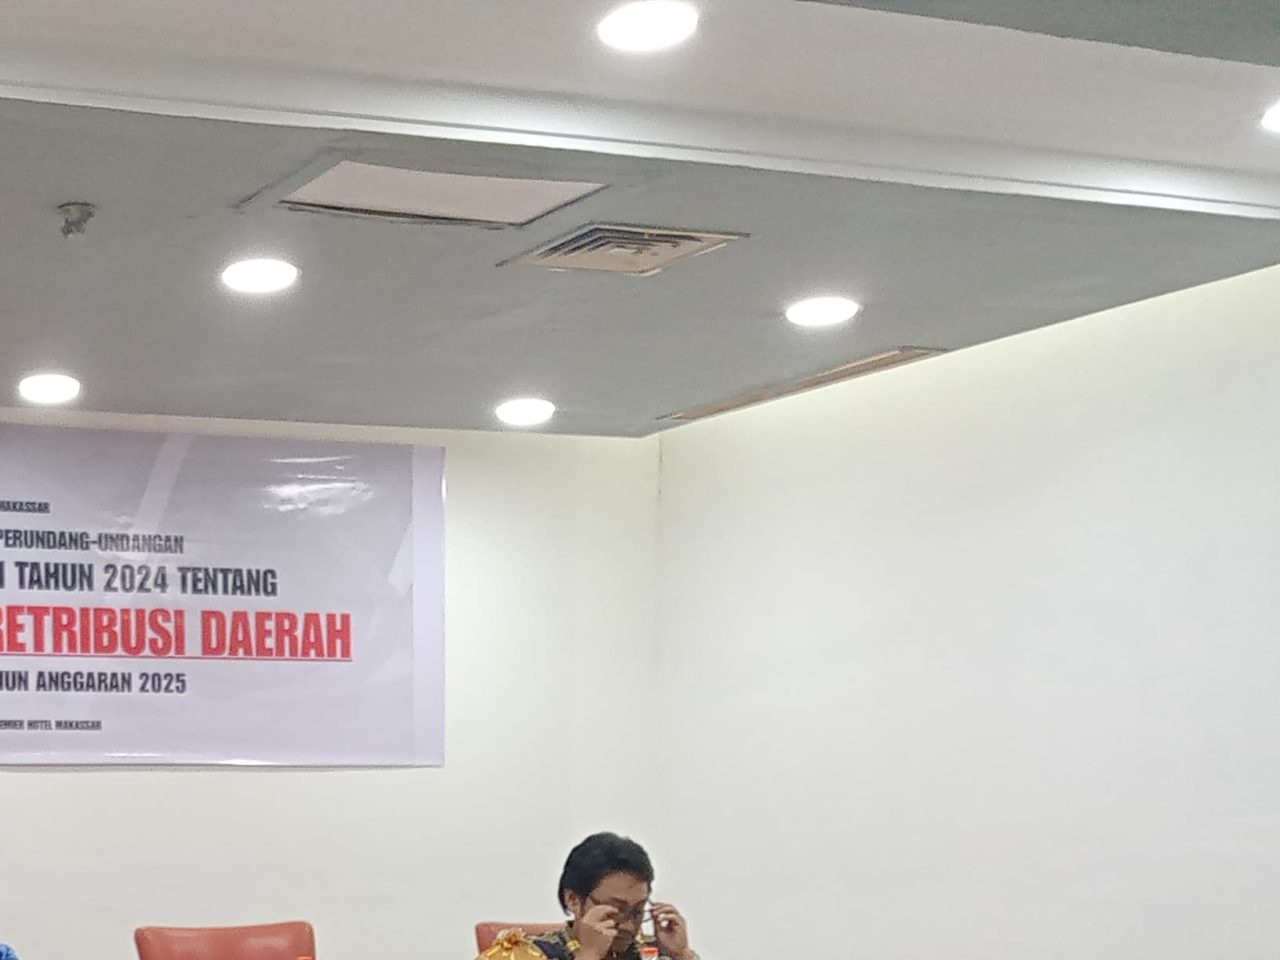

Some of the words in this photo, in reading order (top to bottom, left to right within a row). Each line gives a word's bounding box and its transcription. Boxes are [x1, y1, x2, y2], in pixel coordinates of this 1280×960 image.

[16, 562, 95, 592] TAHUN
[103, 565, 169, 594] 2024
[177, 567, 278, 596] TENTANG
[201, 611, 352, 659] DAERAH
[36, 671, 133, 692] ANGGARAN
[139, 673, 187, 694] 2025
[55, 720, 102, 731] MAKASSAR
